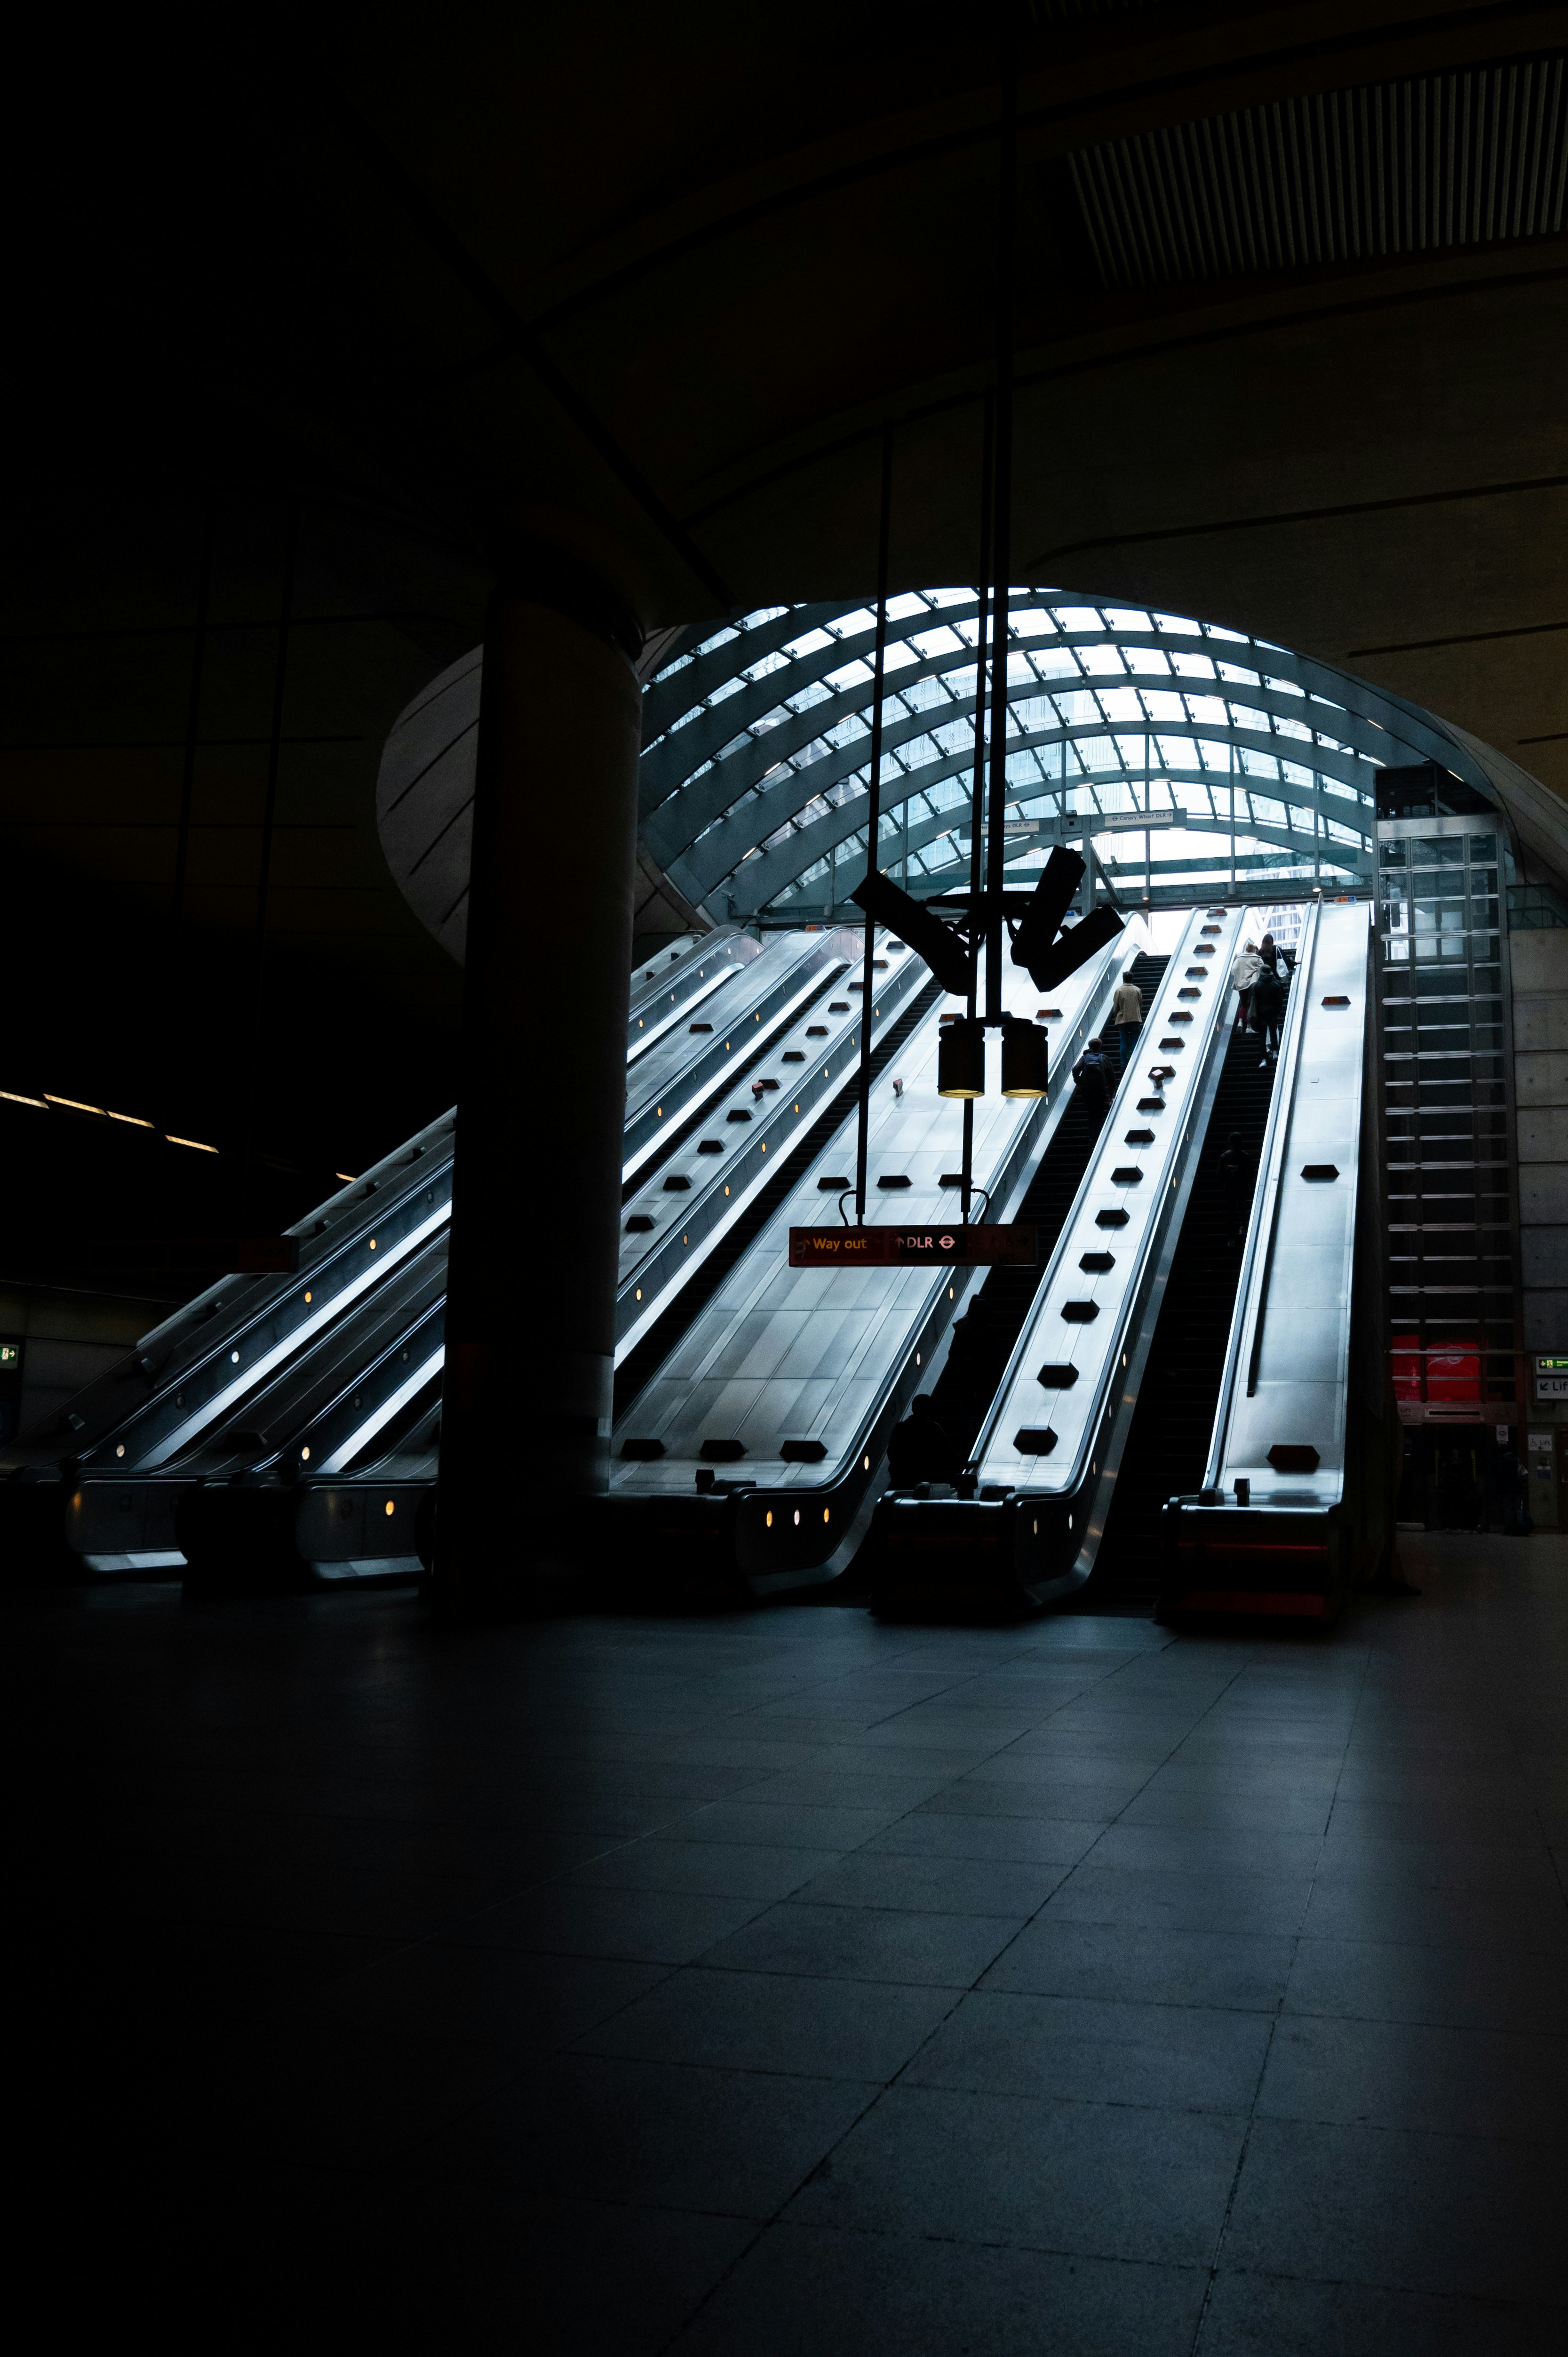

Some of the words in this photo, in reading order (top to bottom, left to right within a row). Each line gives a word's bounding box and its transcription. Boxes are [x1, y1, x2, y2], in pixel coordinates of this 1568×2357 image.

[813, 1238, 840, 1252] Way
[844, 1238, 867, 1249] out
[907, 1237, 933, 1248] DLR
